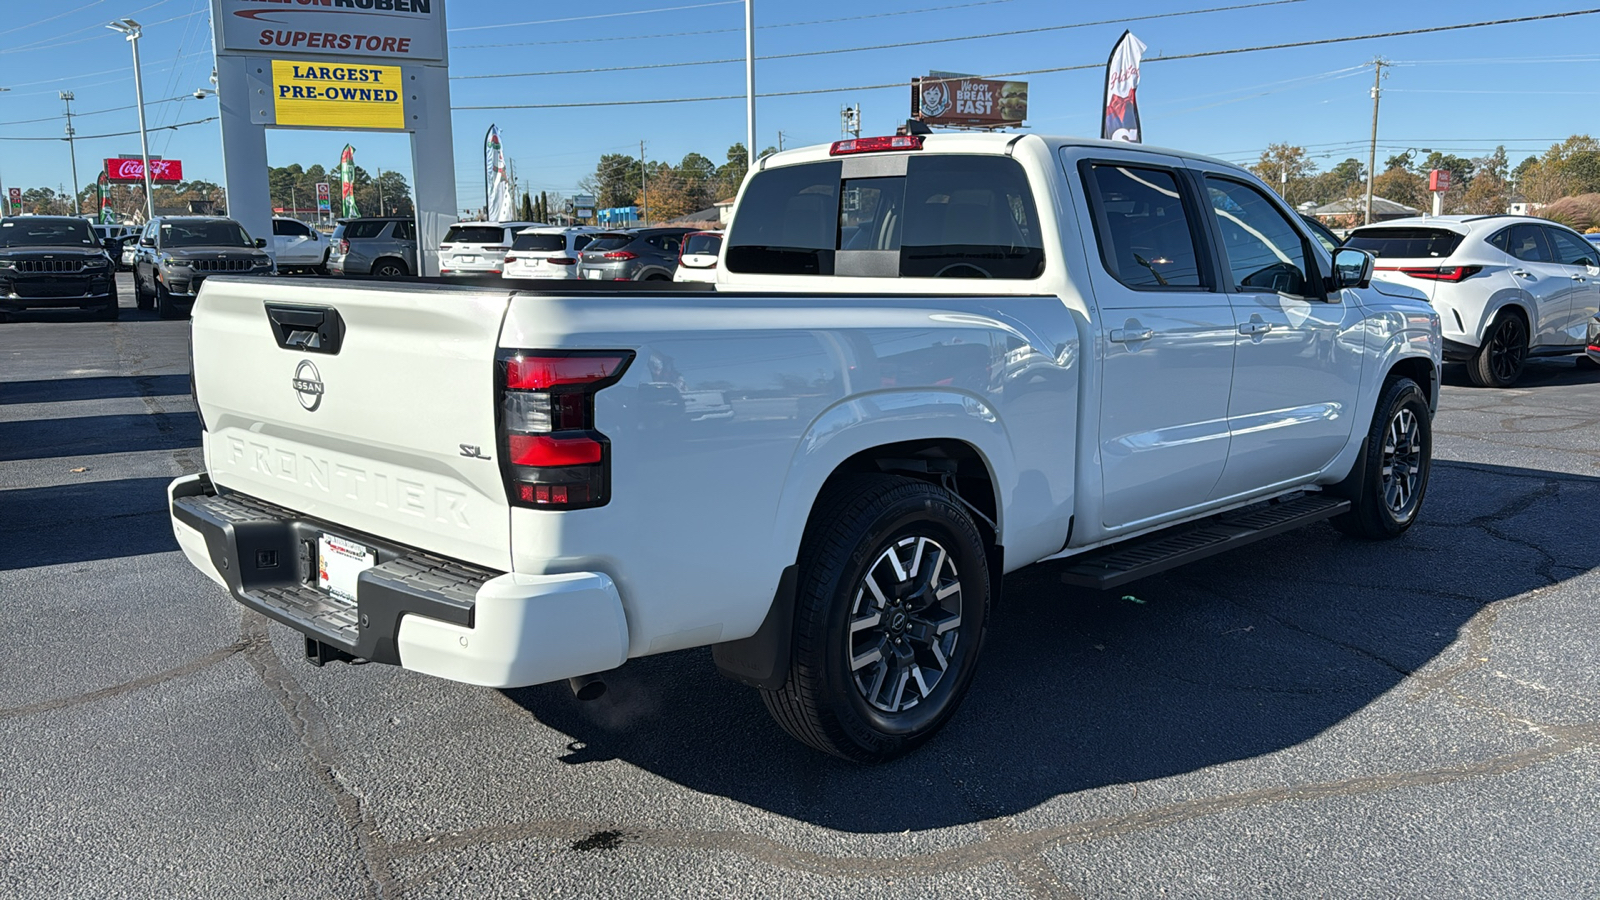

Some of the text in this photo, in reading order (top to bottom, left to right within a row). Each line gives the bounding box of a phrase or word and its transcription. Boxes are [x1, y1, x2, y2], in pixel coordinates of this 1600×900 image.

[259, 29, 411, 53] SUPERSTORE
[293, 66, 382, 82] LARGEST
[279, 85, 398, 102] PRE-OWNED
[956, 90, 993, 101] BREAK
[956, 100, 993, 115] FAST
[459, 443, 491, 461] SL
[227, 434, 471, 529] FRONTIER
